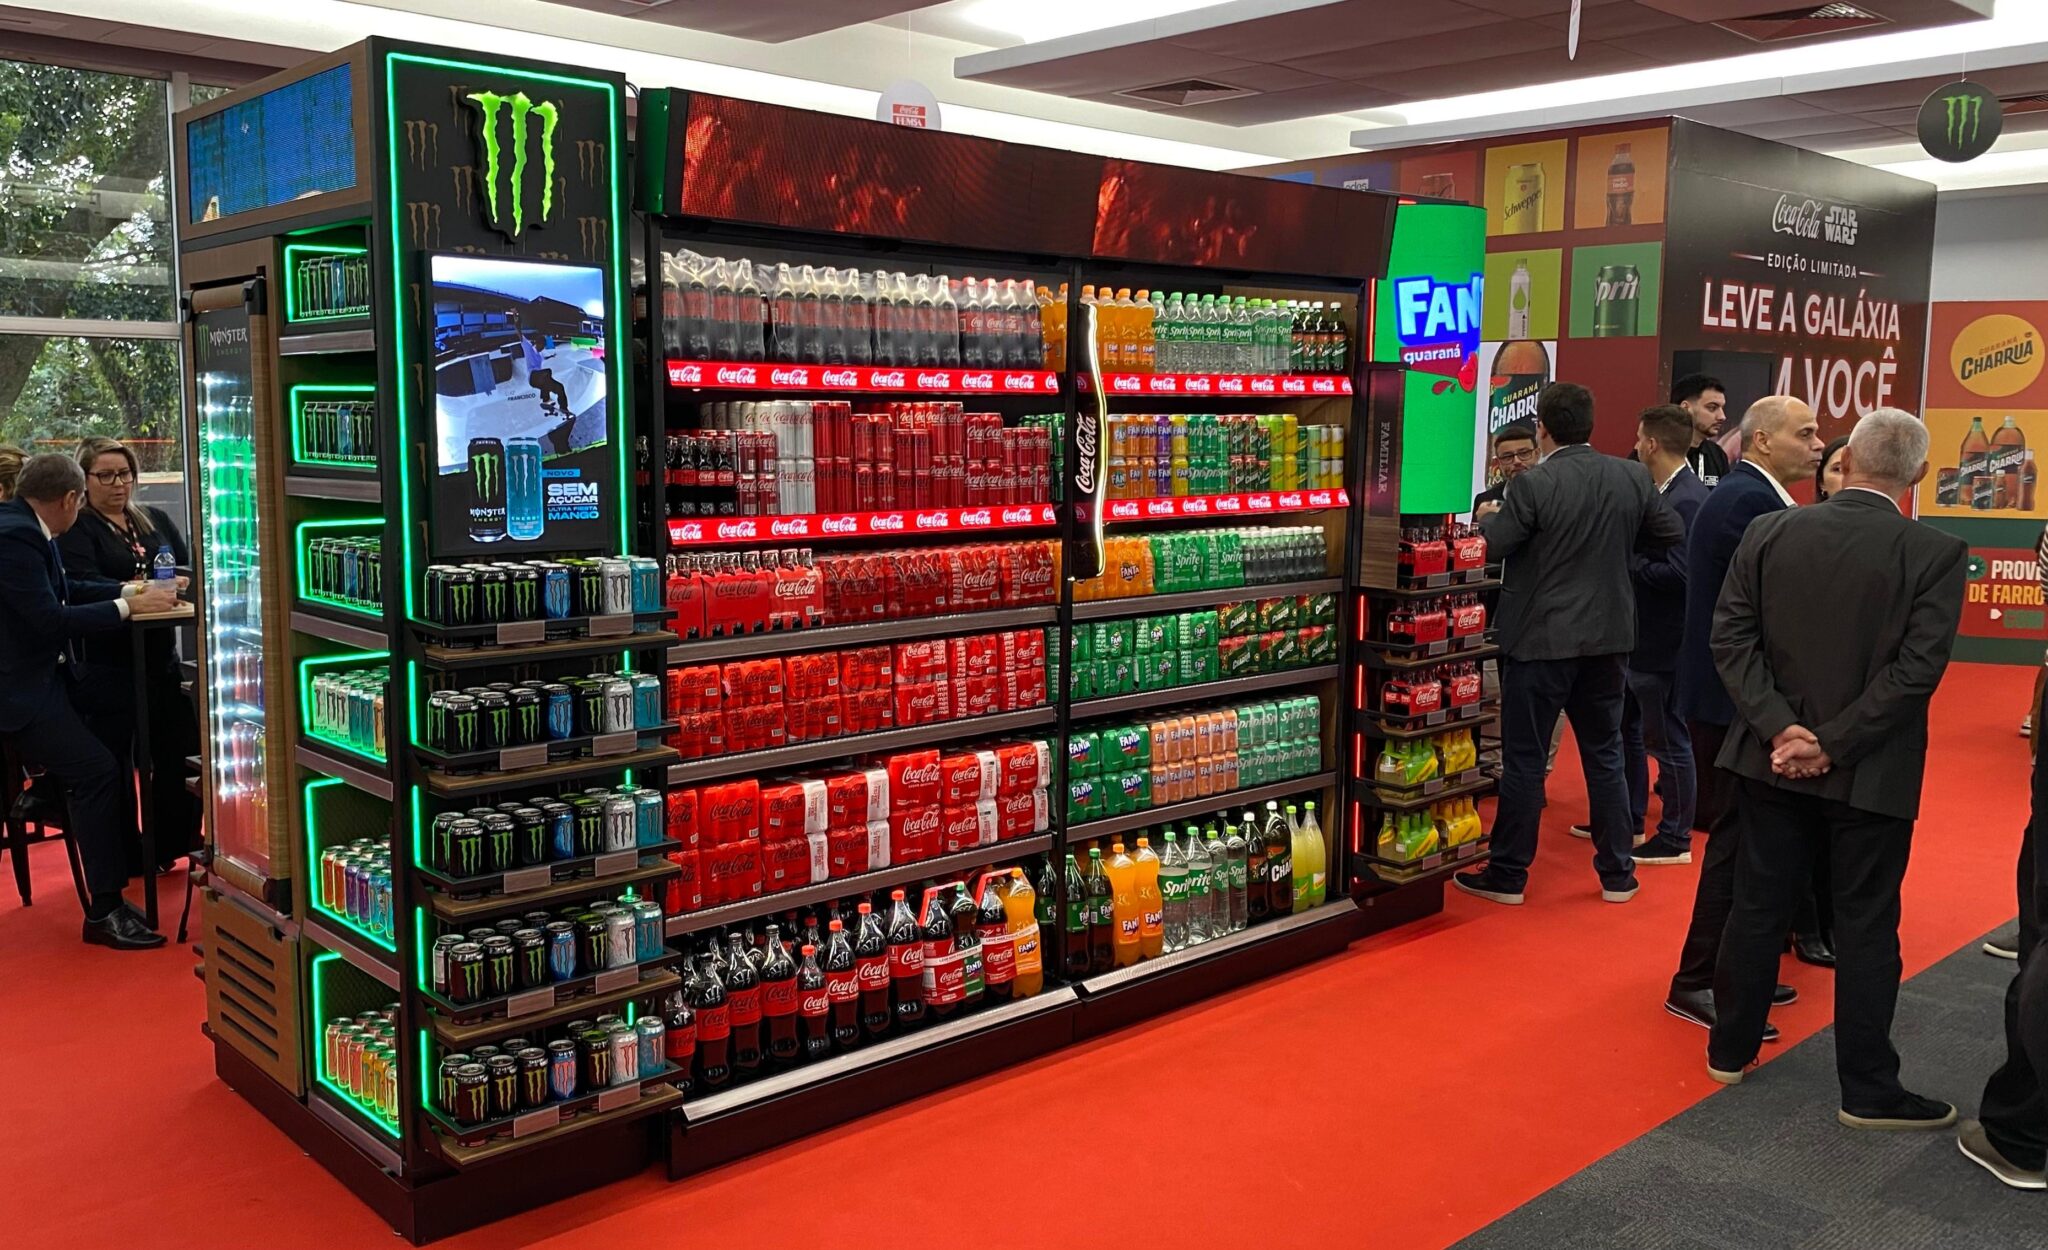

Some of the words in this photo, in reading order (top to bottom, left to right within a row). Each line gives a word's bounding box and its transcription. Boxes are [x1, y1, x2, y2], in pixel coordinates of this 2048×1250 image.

[1772, 194, 1823, 239] Coca-Cola
[1825, 206, 1858, 227] STAR
[1825, 223, 1858, 245] WARS
[1767, 253, 1807, 273] EDIÇÃO
[1810, 260, 1857, 279] LIMITADA
[1398, 276, 1484, 337] FAN
[1703, 282, 1774, 331] LEVE
[1779, 292, 1796, 333] A
[1804, 288, 1900, 341] GALÁXIA
[209, 327, 248, 347] MONSTER
[1404, 344, 1461, 365] guaraná
[1961, 339, 2034, 380] CHARRUA
[1776, 357, 1793, 396] A
[1804, 346, 1898, 419] VOCÊ
[507, 393, 536, 401] FRANCISCO
[1075, 412, 1096, 494] Coca-Cola
[1378, 421, 1391, 494] FAMILIAR
[547, 482, 598, 496] SEM
[548, 511, 599, 521] MANGO
[1175, 553, 1199, 568] Sprite
[1221, 551, 1243, 566] Sprite
[1460, 544, 1482, 560] Coca-Cola
[963, 570, 997, 588] Coca-Cola
[1020, 566, 1051, 583] Coca-Cola
[1120, 566, 1140, 578] FANTA
[715, 579, 758, 597] Coca-Cola
[774, 577, 816, 597] Coca-Cola
[1968, 583, 1989, 603] DE
[1458, 611, 1480, 627] Coca-Cola
[907, 643, 931, 656] Coca-Cola
[1016, 645, 1037, 658] Coca-Cola
[969, 654, 991, 666] Coca-Cola
[1020, 687, 1040, 700] Coca-Cola
[1416, 688, 1439, 705] Coca-Cola
[1457, 680, 1479, 697] Coca-Cola
[911, 694, 935, 707] Coca-Cola
[970, 693, 992, 705] Coca-Cola
[1069, 738, 1091, 754] FANTA
[1119, 731, 1140, 747] FANTA
[1009, 752, 1037, 769] Coca-Cola
[902, 763, 940, 785] Coca-Cola
[951, 766, 979, 783] Coca-Cola
[1121, 773, 1142, 789] FANTA
[1071, 782, 1093, 798] FANTA
[710, 799, 753, 821] Coca-Cola
[1006, 794, 1033, 813] Coca-Cola
[903, 810, 939, 836] Coca-Cola
[948, 816, 977, 835] Coca-Cola
[710, 852, 754, 874] Coca-Cola
[987, 948, 1013, 963] Coca-Cola
[940, 967, 963, 983] Coca-Cola
